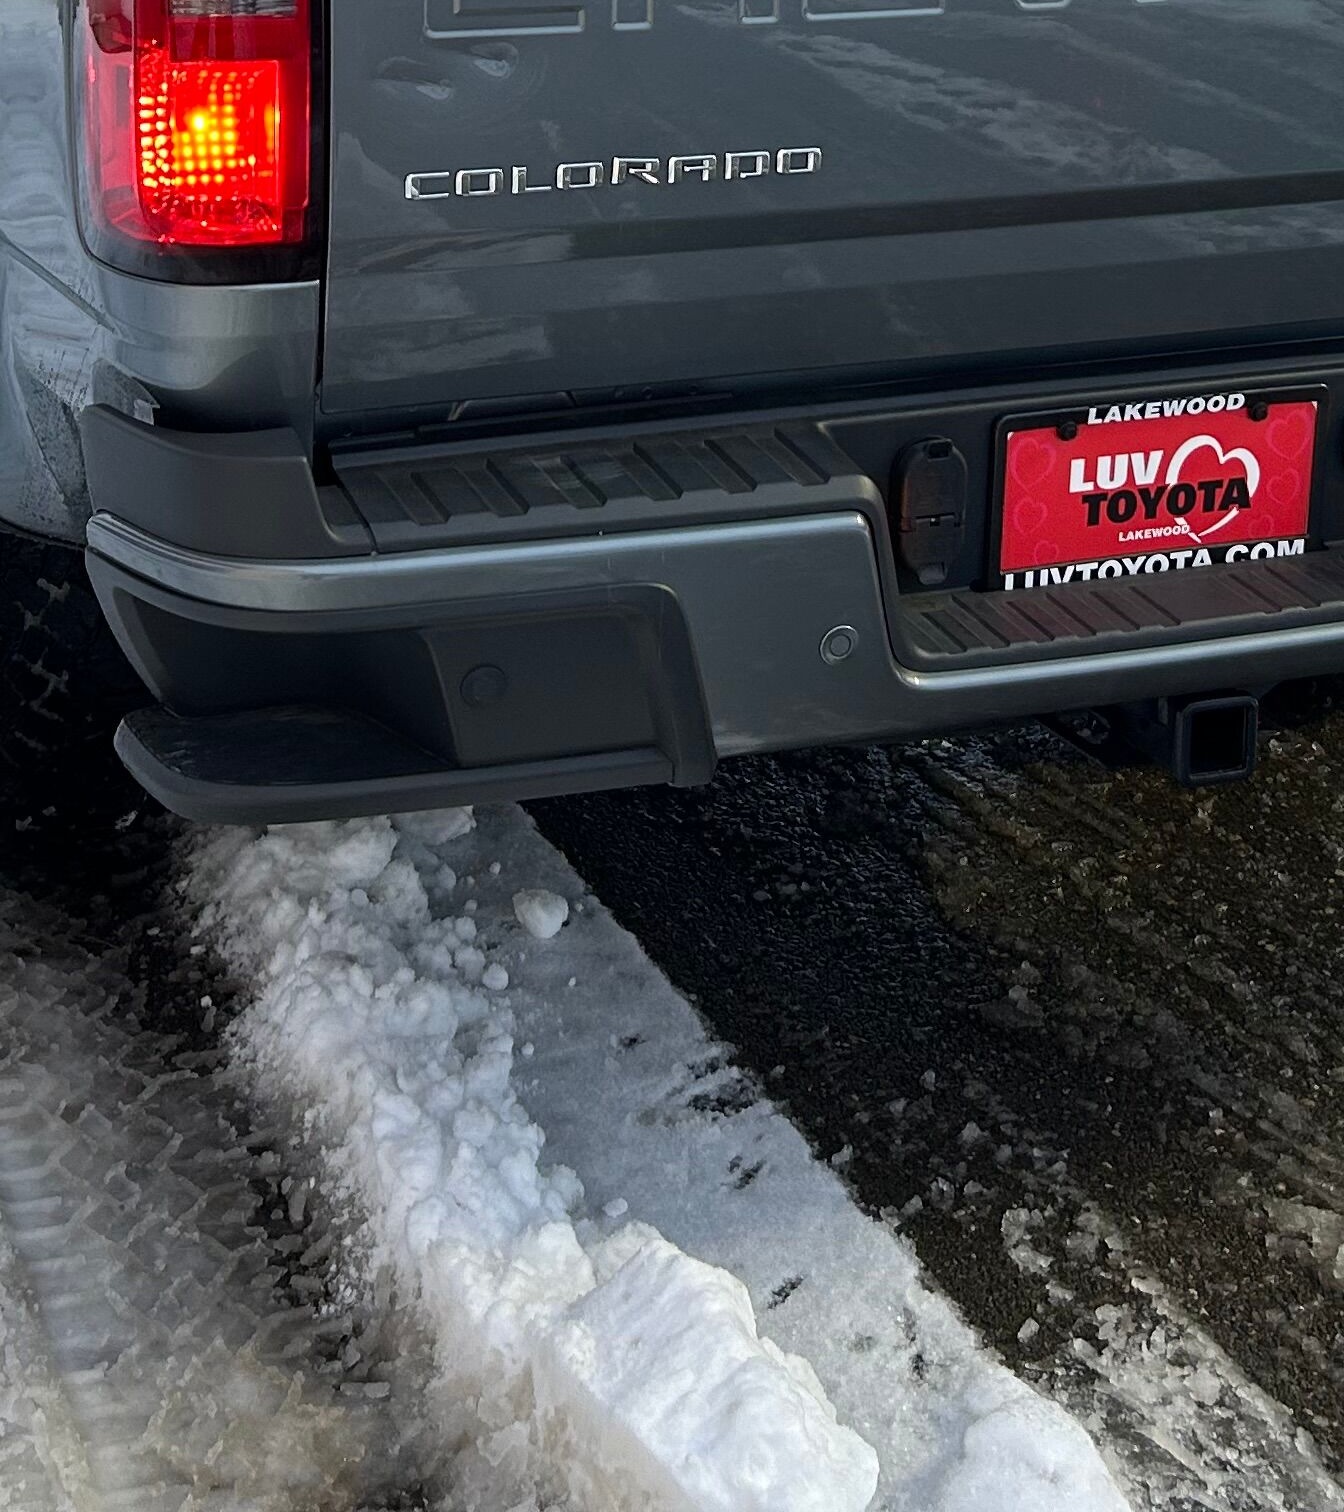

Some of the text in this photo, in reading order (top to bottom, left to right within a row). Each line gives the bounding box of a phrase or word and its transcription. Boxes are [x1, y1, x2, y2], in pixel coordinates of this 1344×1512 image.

[405, 147, 822, 199] COLORADO
[1087, 393, 1245, 425] LAKEWOOD
[1069, 450, 1164, 493] LUV
[1082, 478, 1251, 527] TOYOTA
[1118, 524, 1191, 542] LAKEWOOD
[1004, 539, 1305, 590] LUVTOYOTACOM
